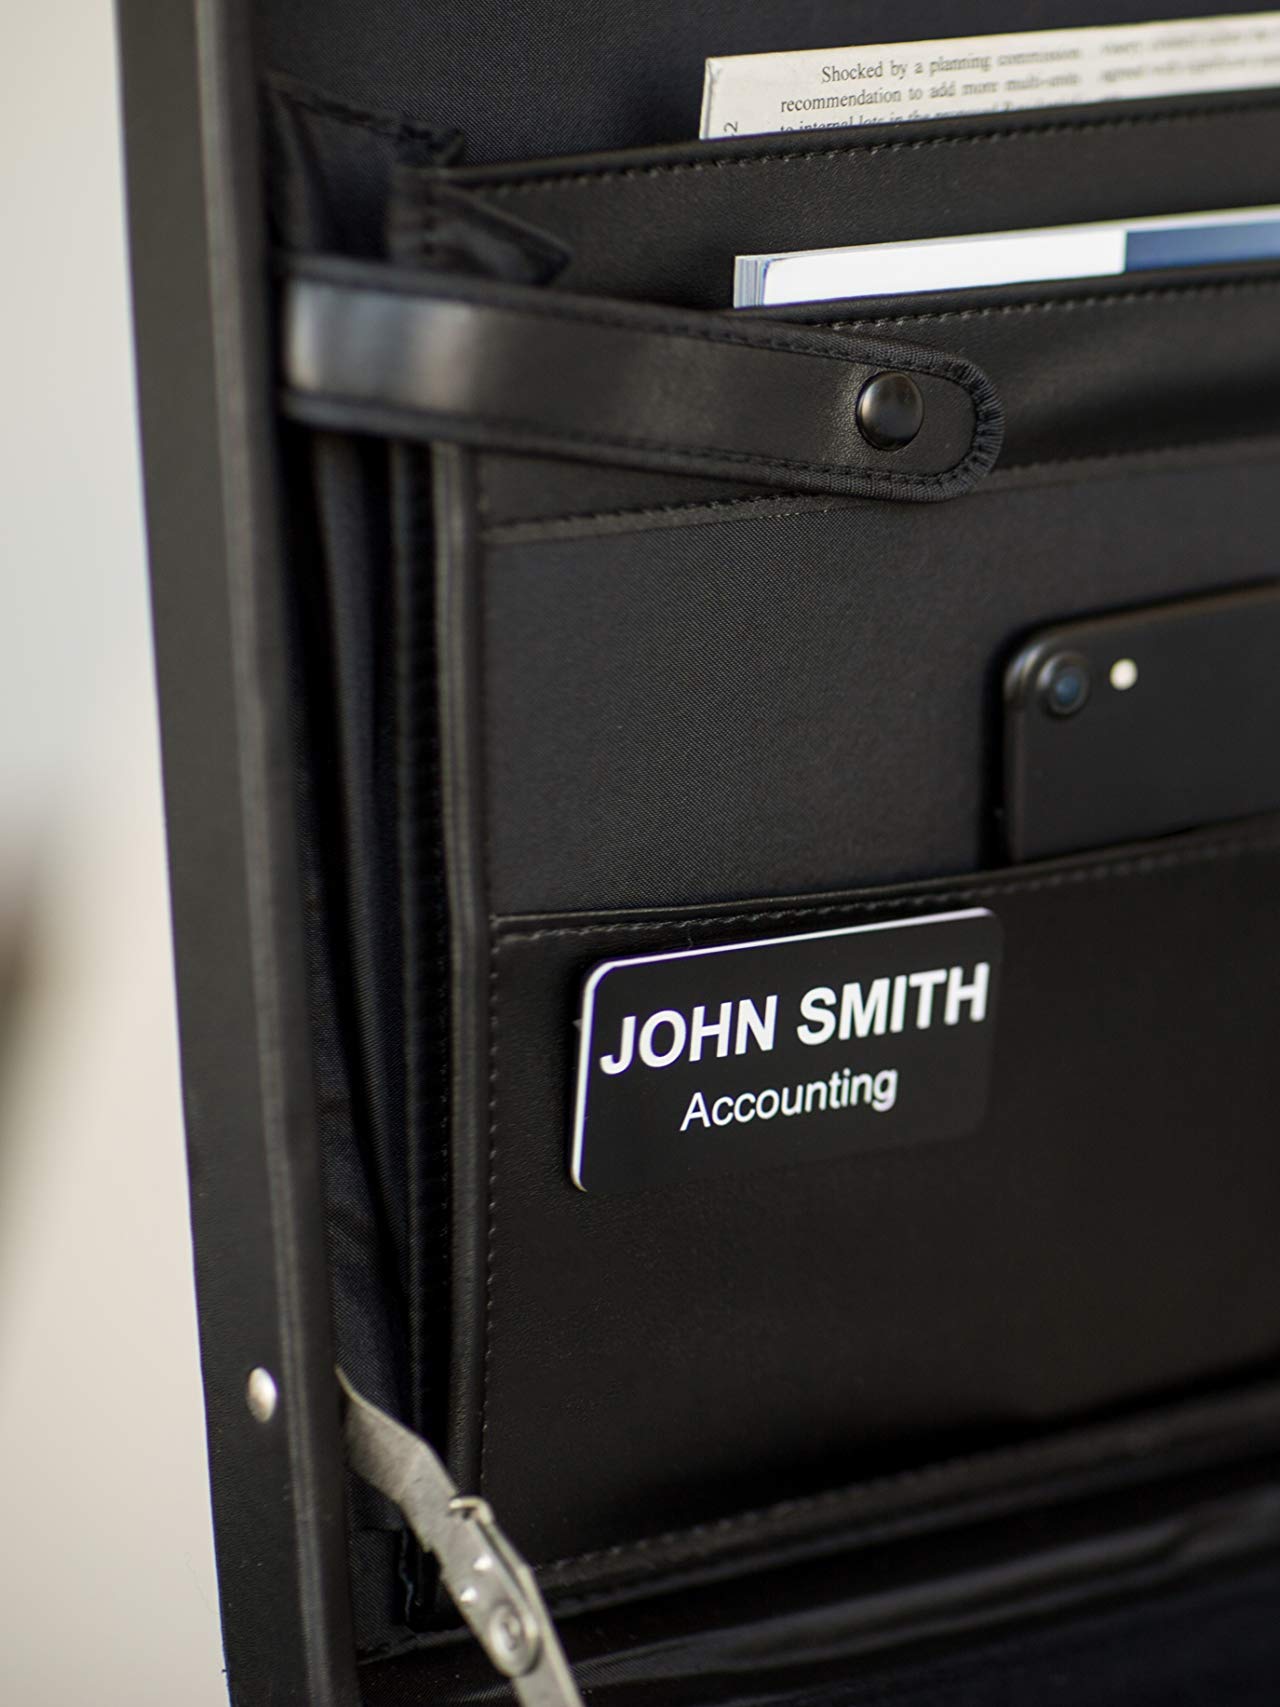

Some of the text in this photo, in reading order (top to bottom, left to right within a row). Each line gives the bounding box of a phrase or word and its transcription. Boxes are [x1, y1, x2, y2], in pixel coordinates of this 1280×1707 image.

[821, 61, 883, 83] Shocked
[890, 60, 907, 80] by
[914, 61, 924, 75] a
[929, 54, 991, 77] planning
[780, 86, 903, 113] recommendation
[908, 87, 923, 101] to
[930, 81, 957, 99] add
[600, 962, 990, 1075] JOHN SMITH
[680, 1067, 899, 1132] Accounting
